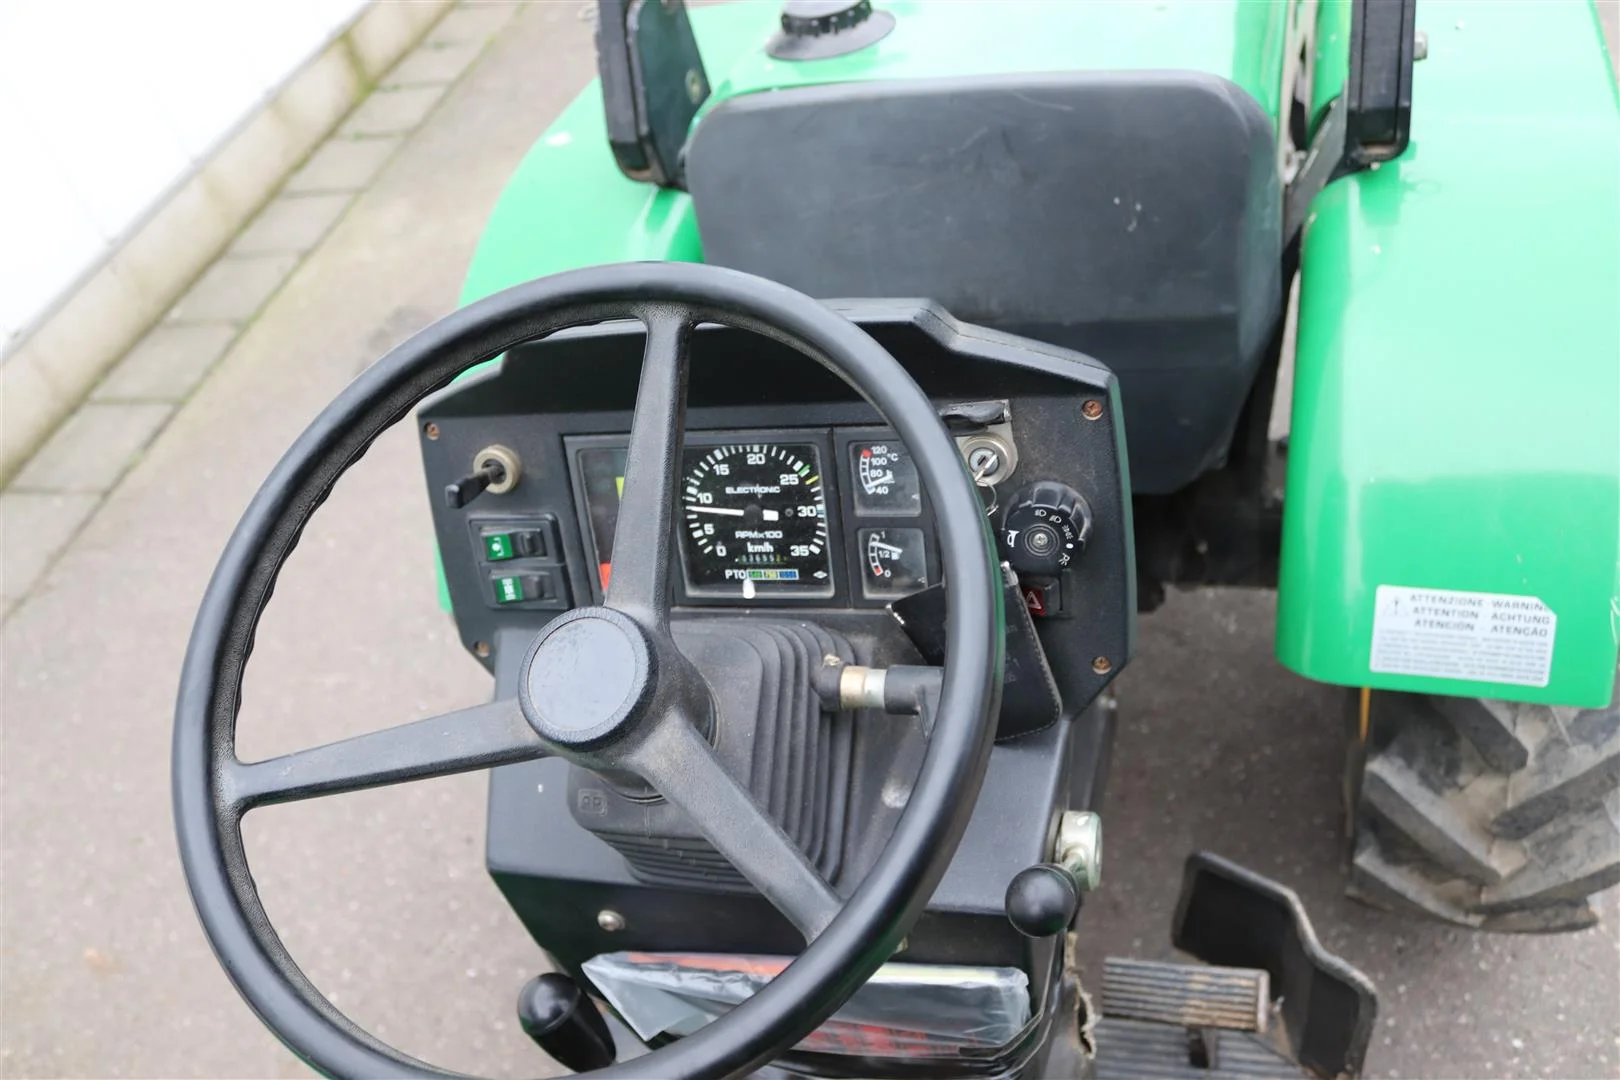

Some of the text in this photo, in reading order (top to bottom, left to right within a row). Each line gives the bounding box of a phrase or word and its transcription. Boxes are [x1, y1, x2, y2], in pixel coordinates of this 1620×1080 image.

[872, 446, 887, 454] 120
[747, 454, 765, 464] 20
[871, 458, 887, 466] 100
[713, 464, 730, 476] 15
[780, 474, 799, 486] 25
[876, 486, 889, 495] 40
[698, 493, 712, 504] 10
[798, 506, 816, 517] 30
[704, 524, 714, 534] 5
[716, 545, 726, 556] 0
[747, 542, 774, 553] km/h
[790, 545, 809, 556] 35
[725, 570, 746, 580] PTO
[884, 570, 891, 578] 0
[1410, 594, 1549, 612] ATTENZIONE WARNIN
[1412, 607, 1550, 626] ATTENTION ACHTUNG
